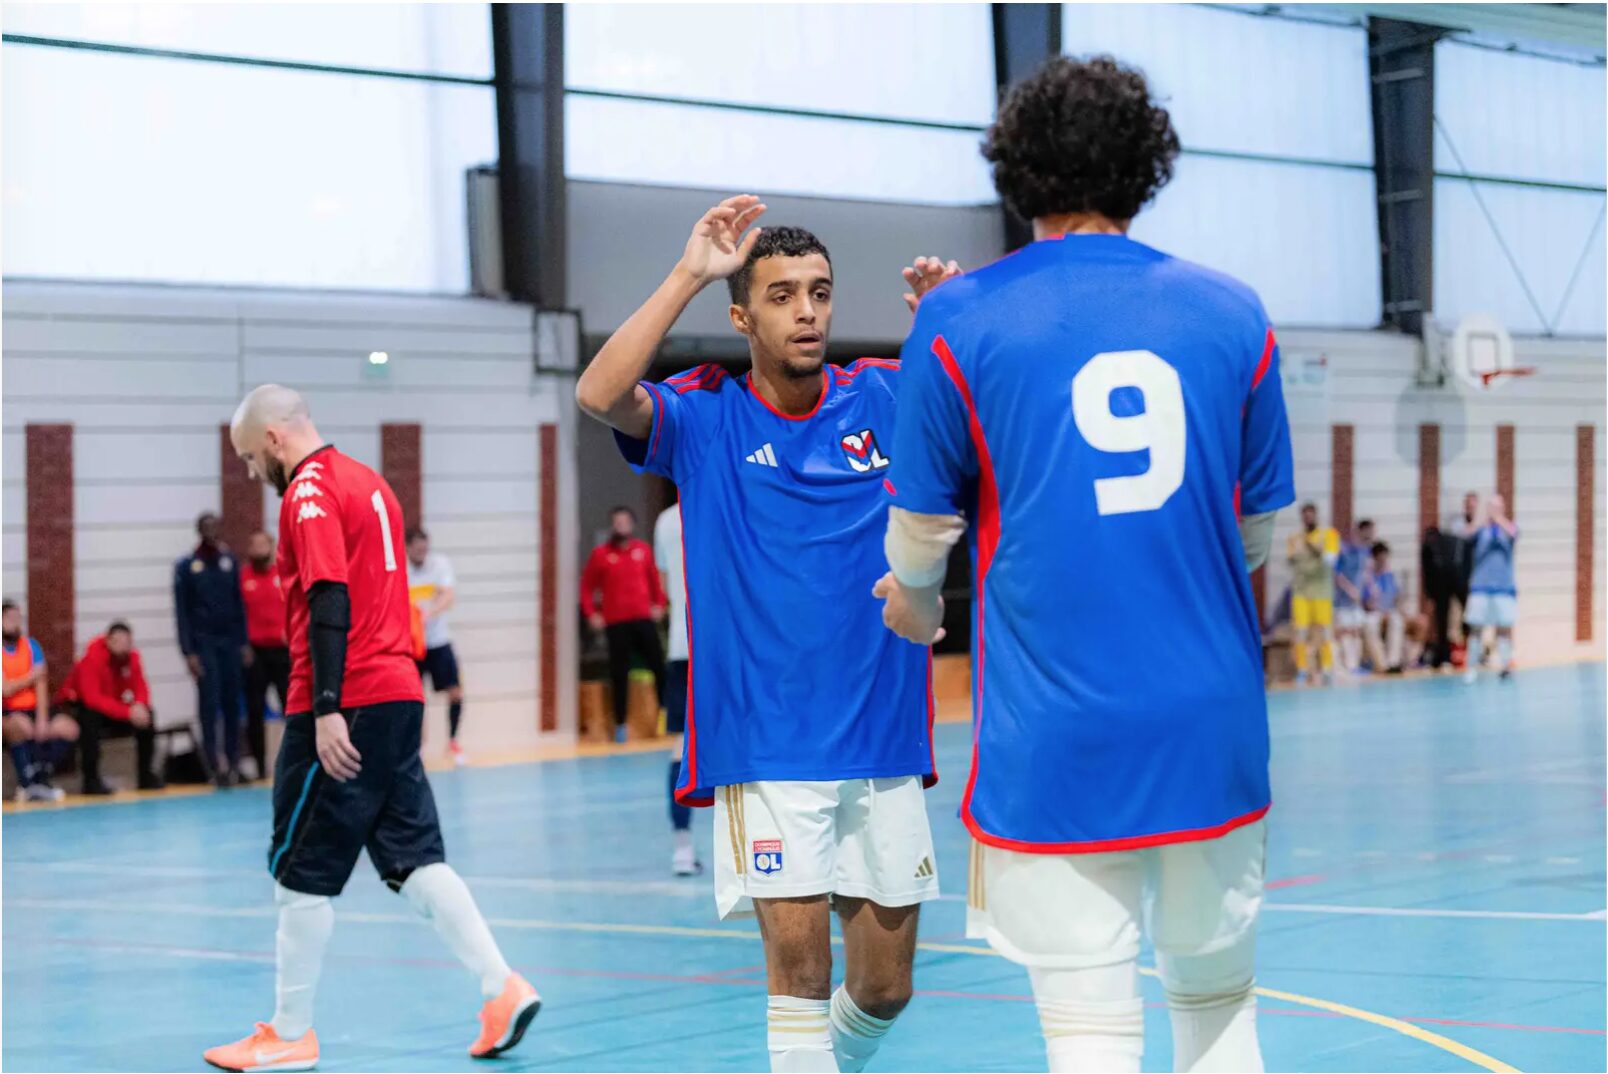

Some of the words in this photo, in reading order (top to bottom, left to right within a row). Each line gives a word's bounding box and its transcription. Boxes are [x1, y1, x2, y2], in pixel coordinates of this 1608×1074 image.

[1071, 350, 1187, 516] 9
[371, 489, 397, 572] 1
[756, 854, 781, 870] OL
